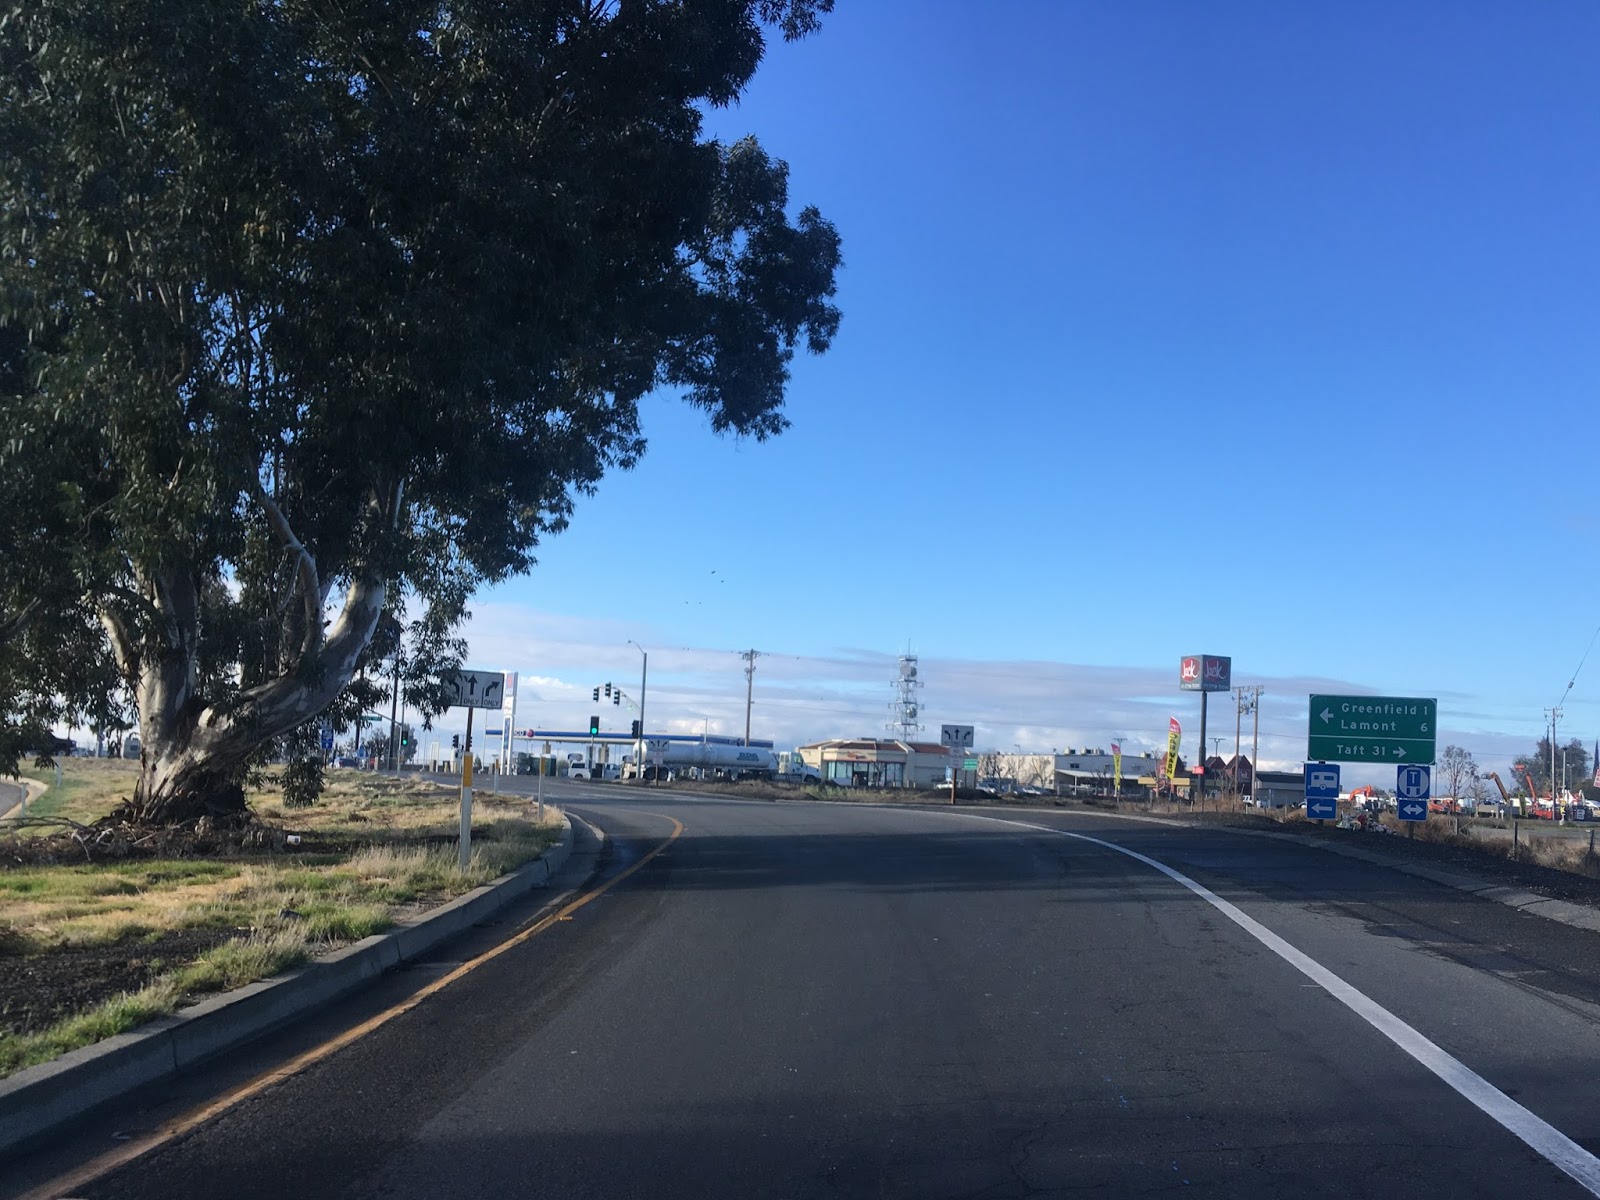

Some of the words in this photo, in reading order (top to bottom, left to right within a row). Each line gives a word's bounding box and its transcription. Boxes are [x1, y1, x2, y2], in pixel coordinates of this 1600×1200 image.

[1341, 702, 1417, 716] Greenfield
[1423, 705, 1428, 715] 1
[1341, 719, 1396, 731] Lamont
[1420, 722, 1428, 732] 6
[1336, 744, 1365, 755] Taft
[1372, 746, 1386, 756] 31
